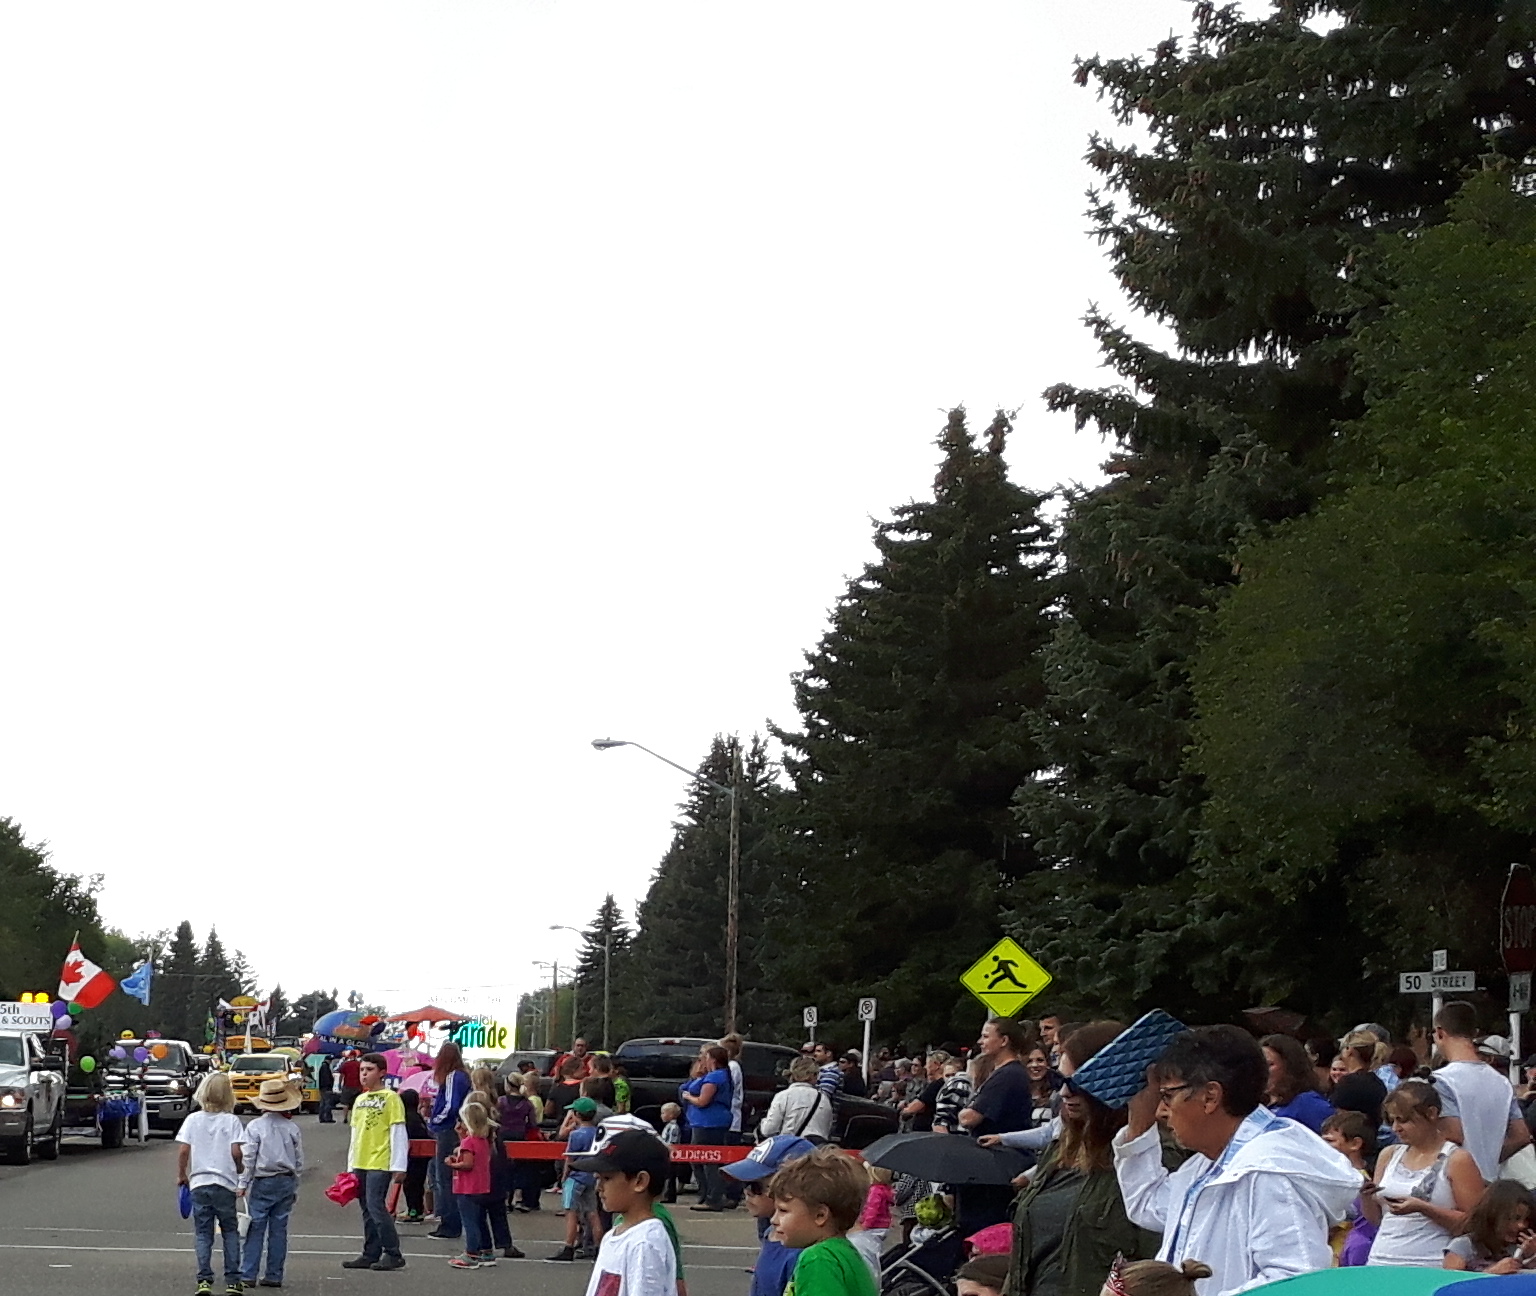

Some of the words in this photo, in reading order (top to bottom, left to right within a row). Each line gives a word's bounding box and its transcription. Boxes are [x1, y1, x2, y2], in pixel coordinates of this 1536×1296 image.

[1404, 975, 1422, 990] 50
[1430, 975, 1467, 988] STREET
[0, 1003, 20, 1014] 5th
[1, 1016, 10, 1025] &
[11, 1016, 51, 1026] SCOUTS
[670, 1149, 722, 1161] OLDINGS
